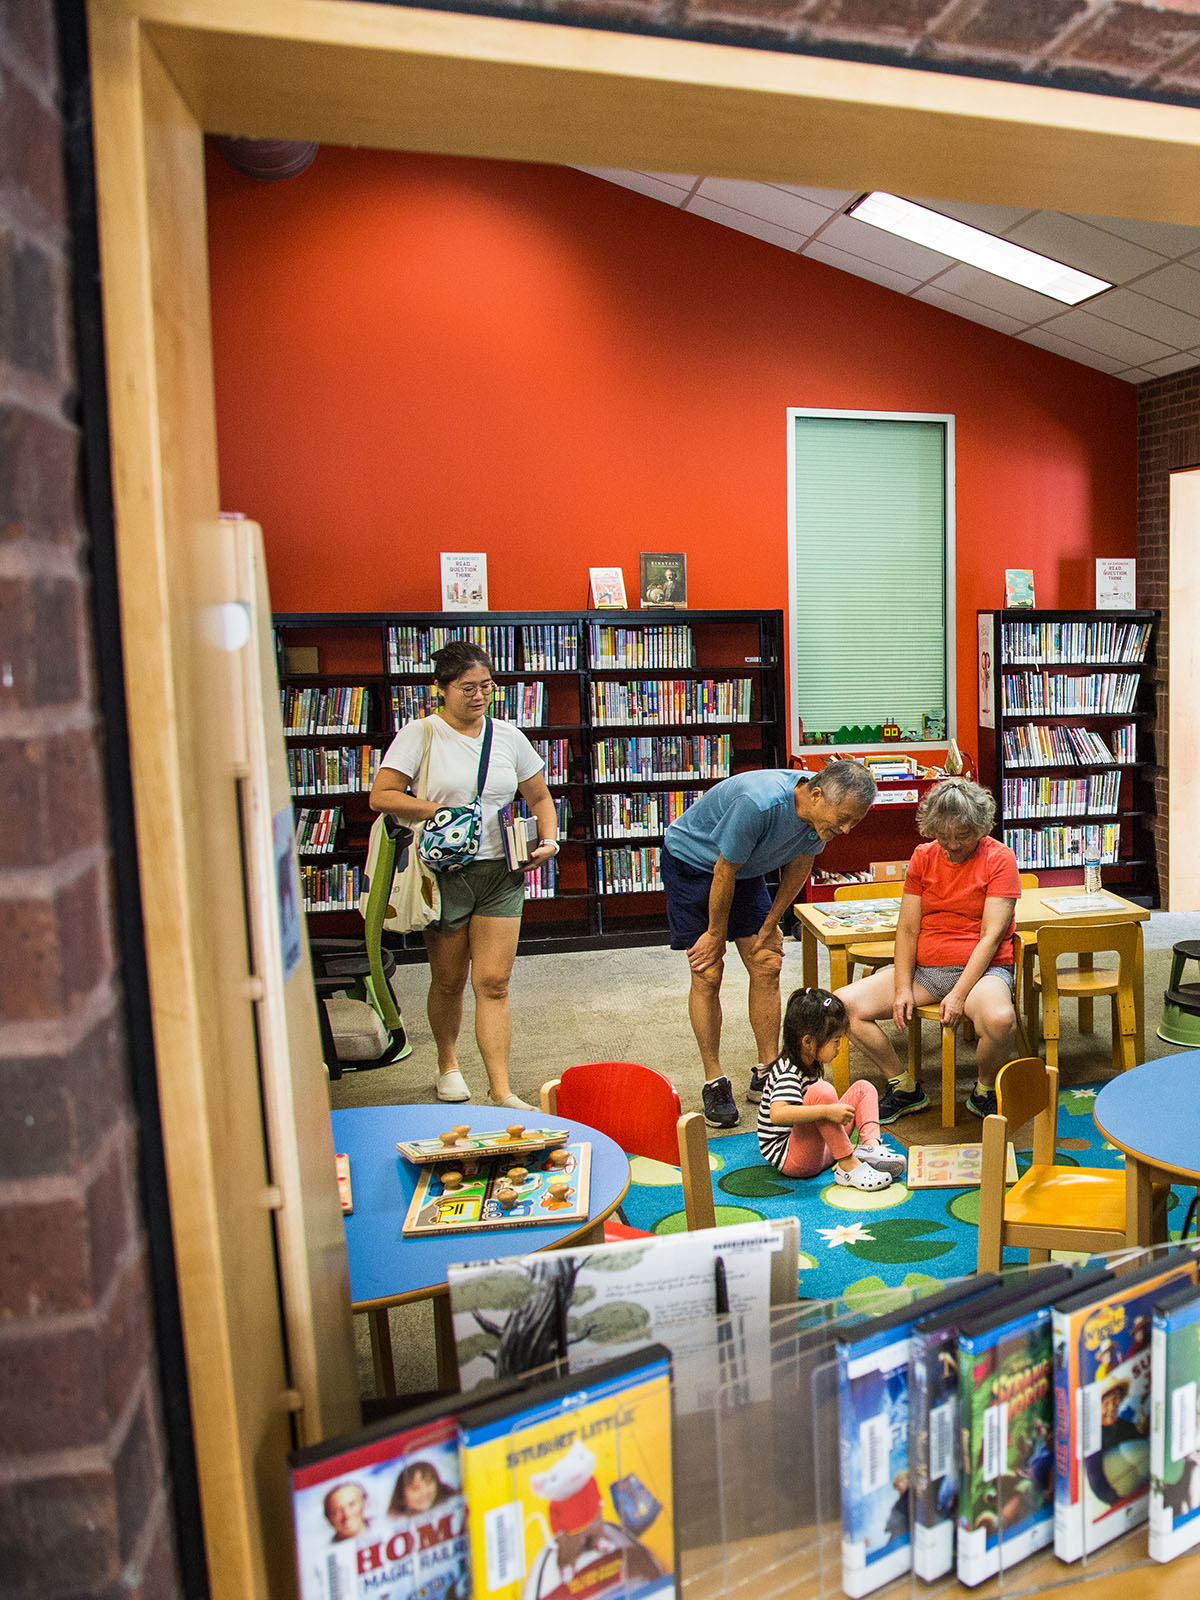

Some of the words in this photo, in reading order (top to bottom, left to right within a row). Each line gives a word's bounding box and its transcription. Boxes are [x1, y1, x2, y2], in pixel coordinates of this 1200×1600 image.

[506, 1430, 577, 1468] STUART
[580, 1406, 637, 1440] LITTLE
[363, 1565, 414, 1592] MAGIC
